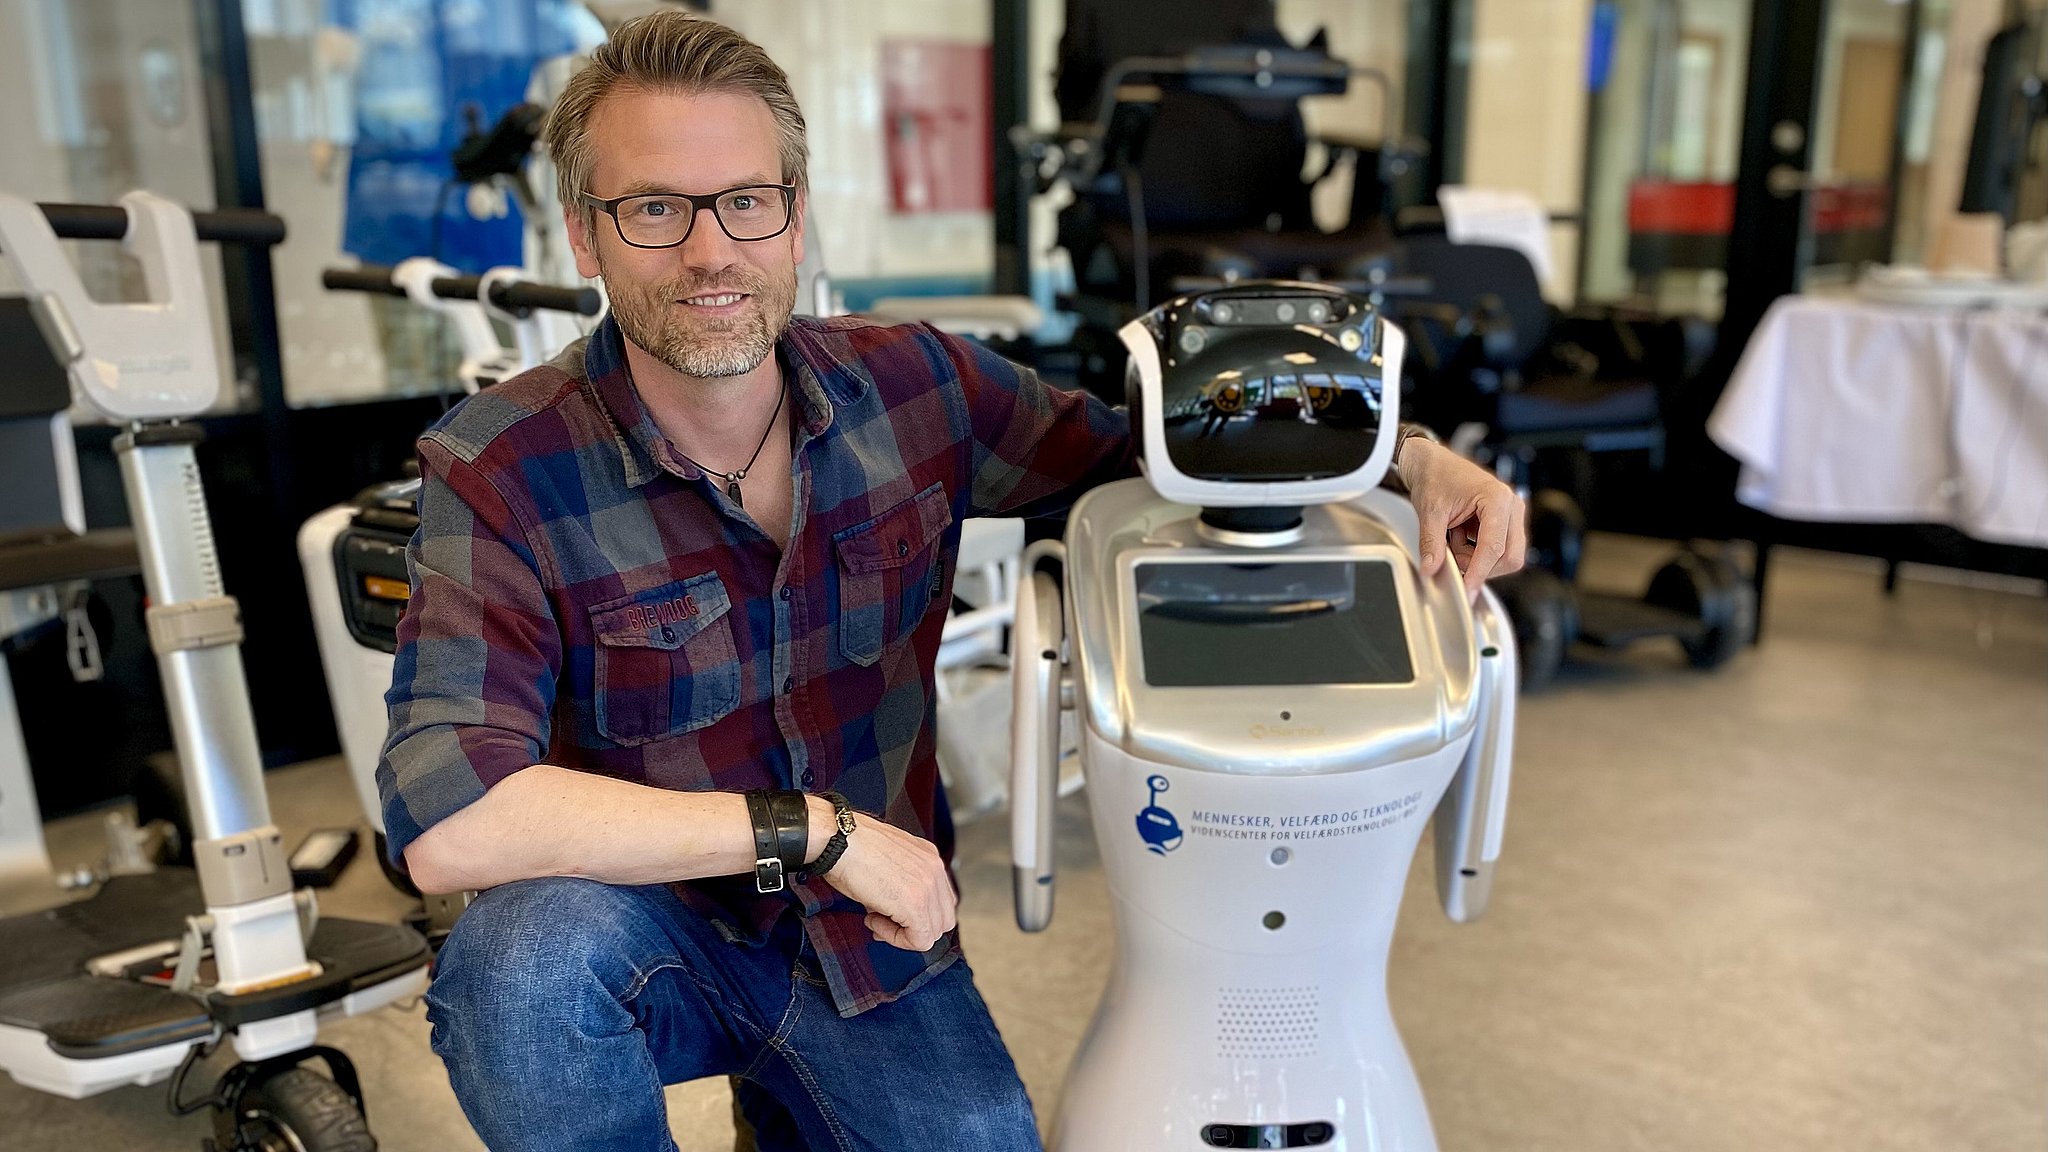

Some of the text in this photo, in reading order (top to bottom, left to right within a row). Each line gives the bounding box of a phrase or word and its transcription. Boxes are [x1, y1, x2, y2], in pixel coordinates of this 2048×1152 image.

[1191, 791, 1423, 828] MENNESKER, VELFÆRD OG TEKNOLOGI
[1191, 825, 1267, 840] VIDENSCENTER
[1270, 830, 1291, 840] FOR
